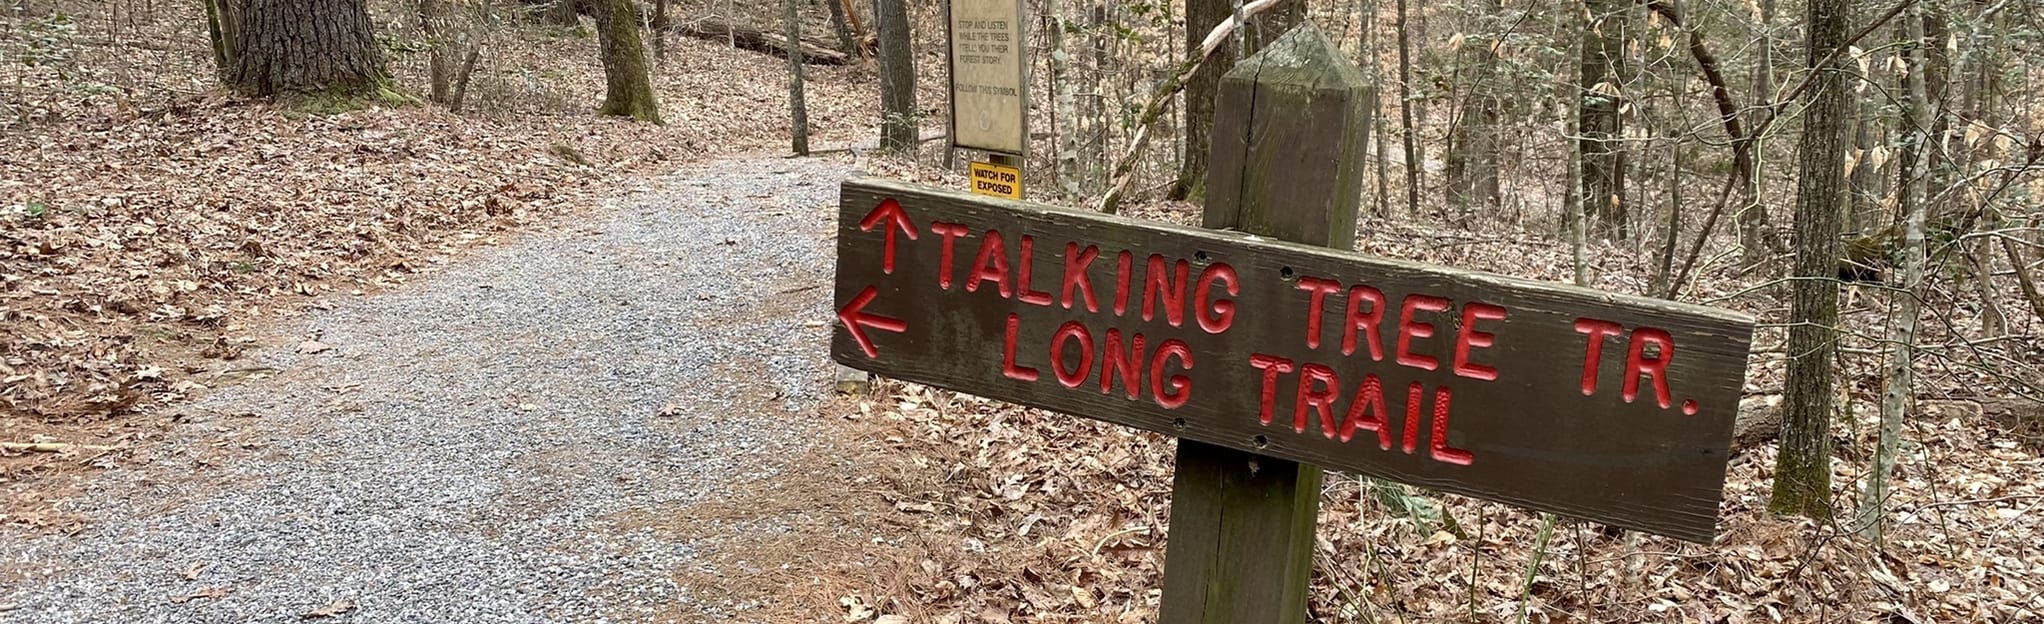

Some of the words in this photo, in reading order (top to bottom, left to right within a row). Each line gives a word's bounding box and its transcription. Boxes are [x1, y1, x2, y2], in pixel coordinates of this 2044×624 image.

[990, 33, 1009, 41] TREES
[974, 168, 998, 180] WATCH
[1000, 172, 1016, 183] FOR
[977, 181, 1012, 194] EXPOSED
[931, 220, 1241, 335] TALKING
[1296, 276, 1508, 382] TREE
[1573, 316, 1699, 416] TR.
[1002, 312, 1195, 410] LONG
[1249, 352, 1475, 466] TRAIL
